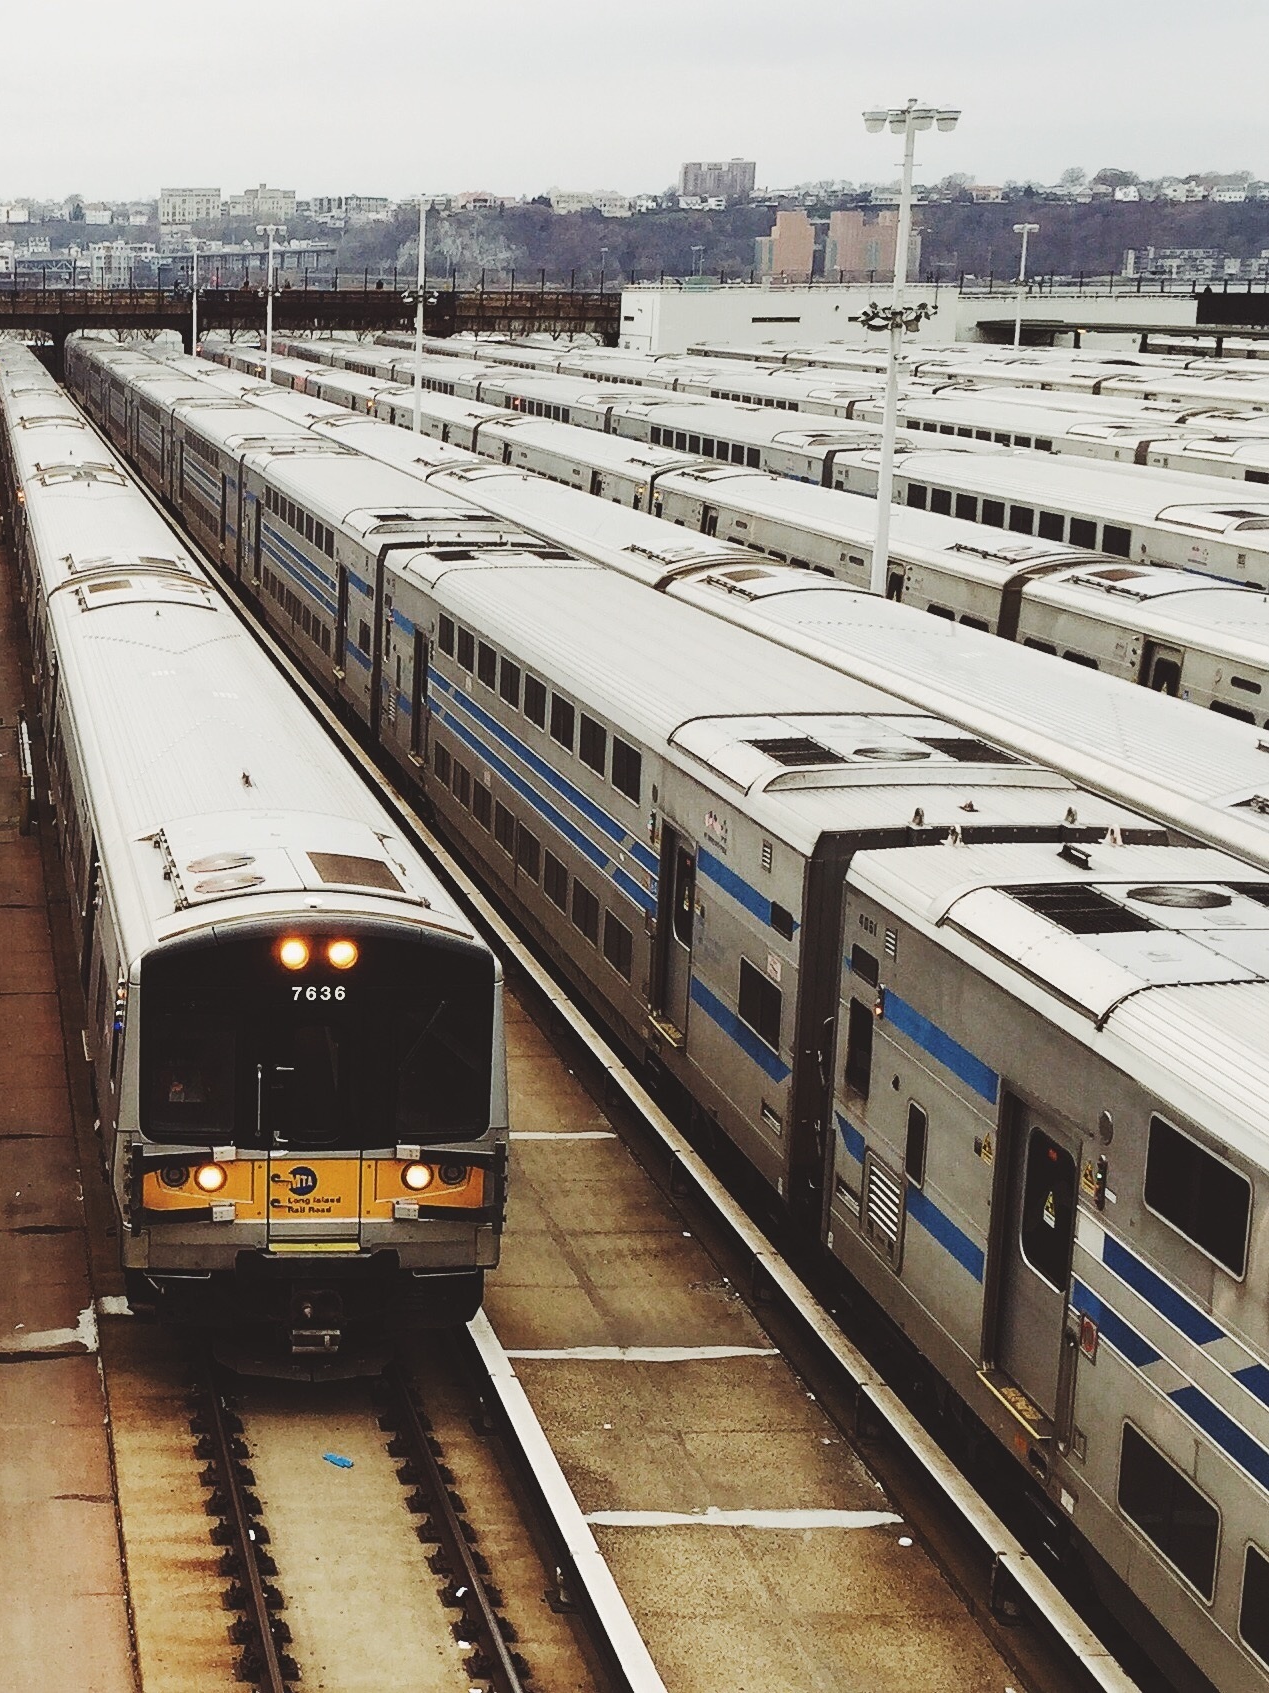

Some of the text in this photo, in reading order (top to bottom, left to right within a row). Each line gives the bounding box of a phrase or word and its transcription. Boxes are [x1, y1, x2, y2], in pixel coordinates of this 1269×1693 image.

[291, 985, 346, 1001] 7636
[287, 1196, 341, 1206] Long Island
[287, 1206, 332, 1214] Rail Road
